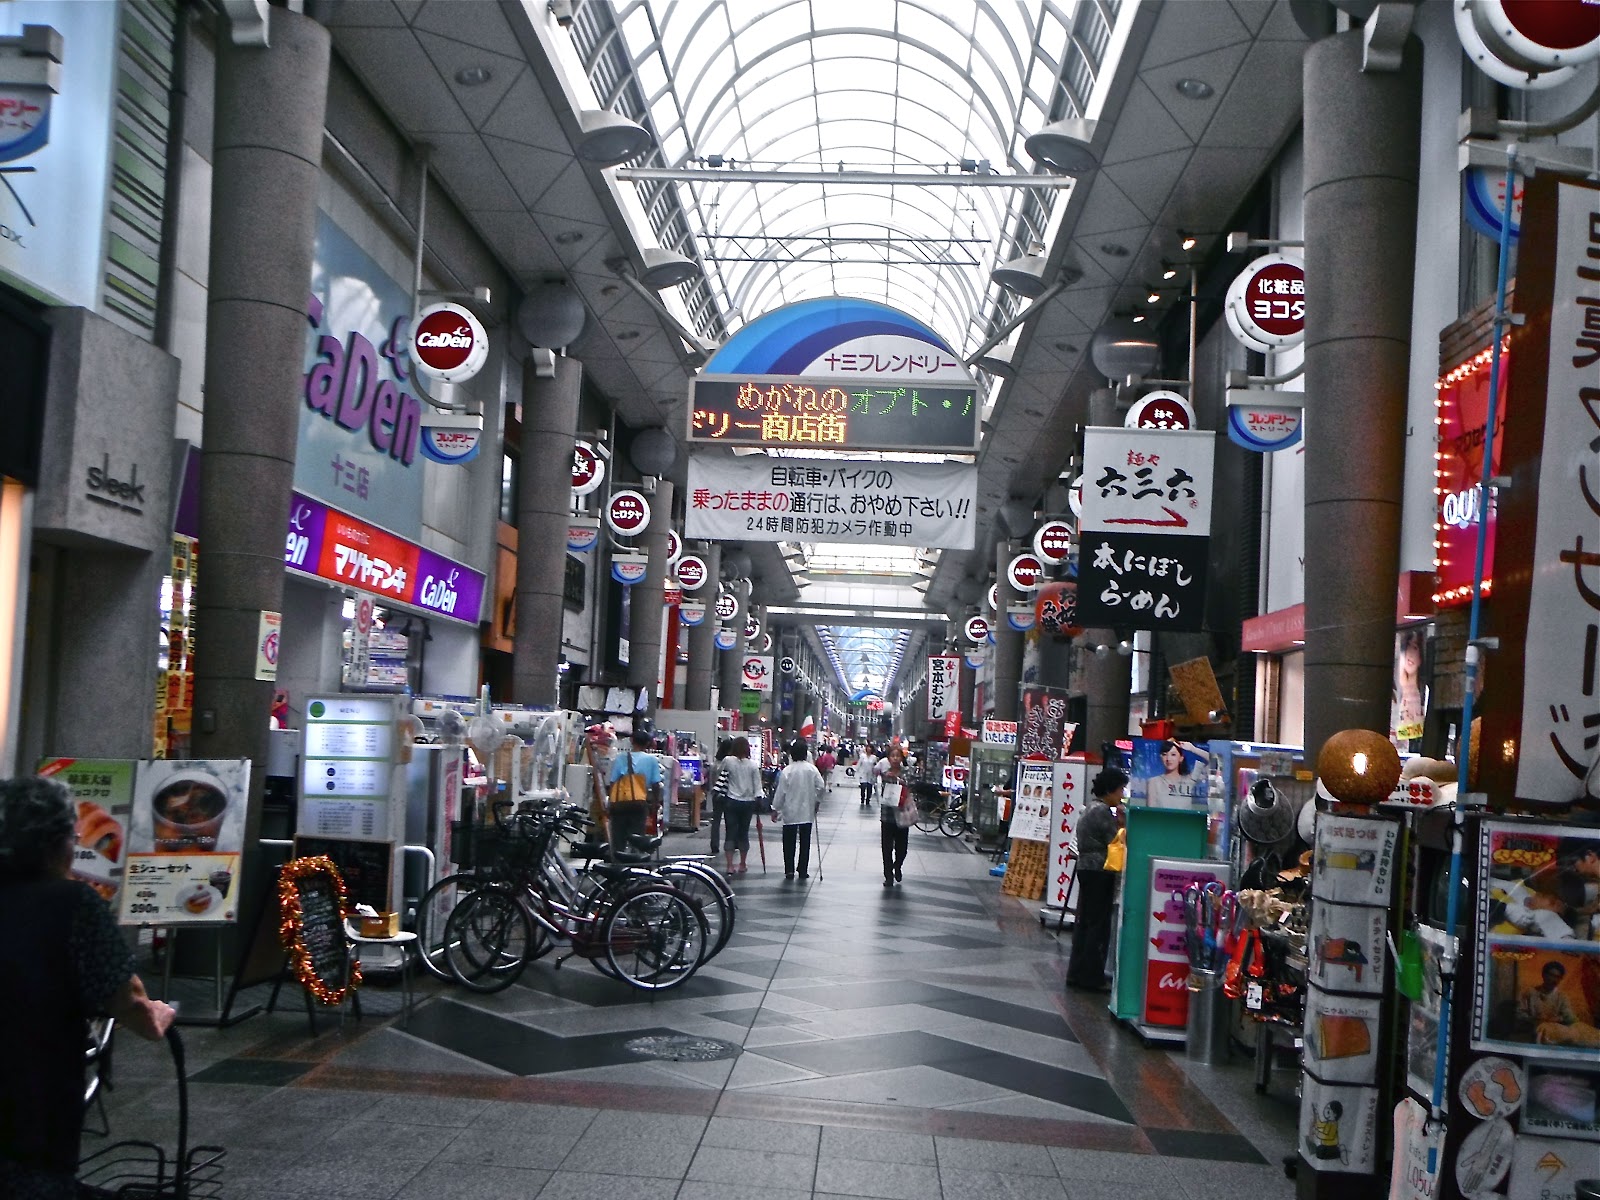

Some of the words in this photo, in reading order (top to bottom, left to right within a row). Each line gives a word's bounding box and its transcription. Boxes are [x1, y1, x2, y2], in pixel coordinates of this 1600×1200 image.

[1257, 278, 1305, 295] 化粧品
[417, 331, 472, 349] CaDen
[824, 353, 957, 374] 十三フレンドリー
[303, 293, 422, 468] aDen
[1248, 412, 1297, 425] フレンドリー
[436, 432, 474, 442] フレンドリー
[1250, 425, 1293, 433] ストリート
[331, 453, 370, 500] 十三店
[771, 465, 893, 489] 自転車・バイクの
[1095, 466, 1197, 501] 六三六
[746, 516, 913, 538] 24時間防犯カメラ作動中
[1014, 568, 1042, 577] APPLE
[1092, 542, 1193, 587] 本にぼし
[420, 574, 458, 614] CaDen
[1099, 580, 1181, 620] らーめん
[931, 658, 945, 720] 宮本むなし
[985, 721, 1018, 734] 電池交換
[984, 732, 1017, 745] いたします
[129, 863, 193, 875] 生シューセット
[130, 903, 160, 914] 390円
